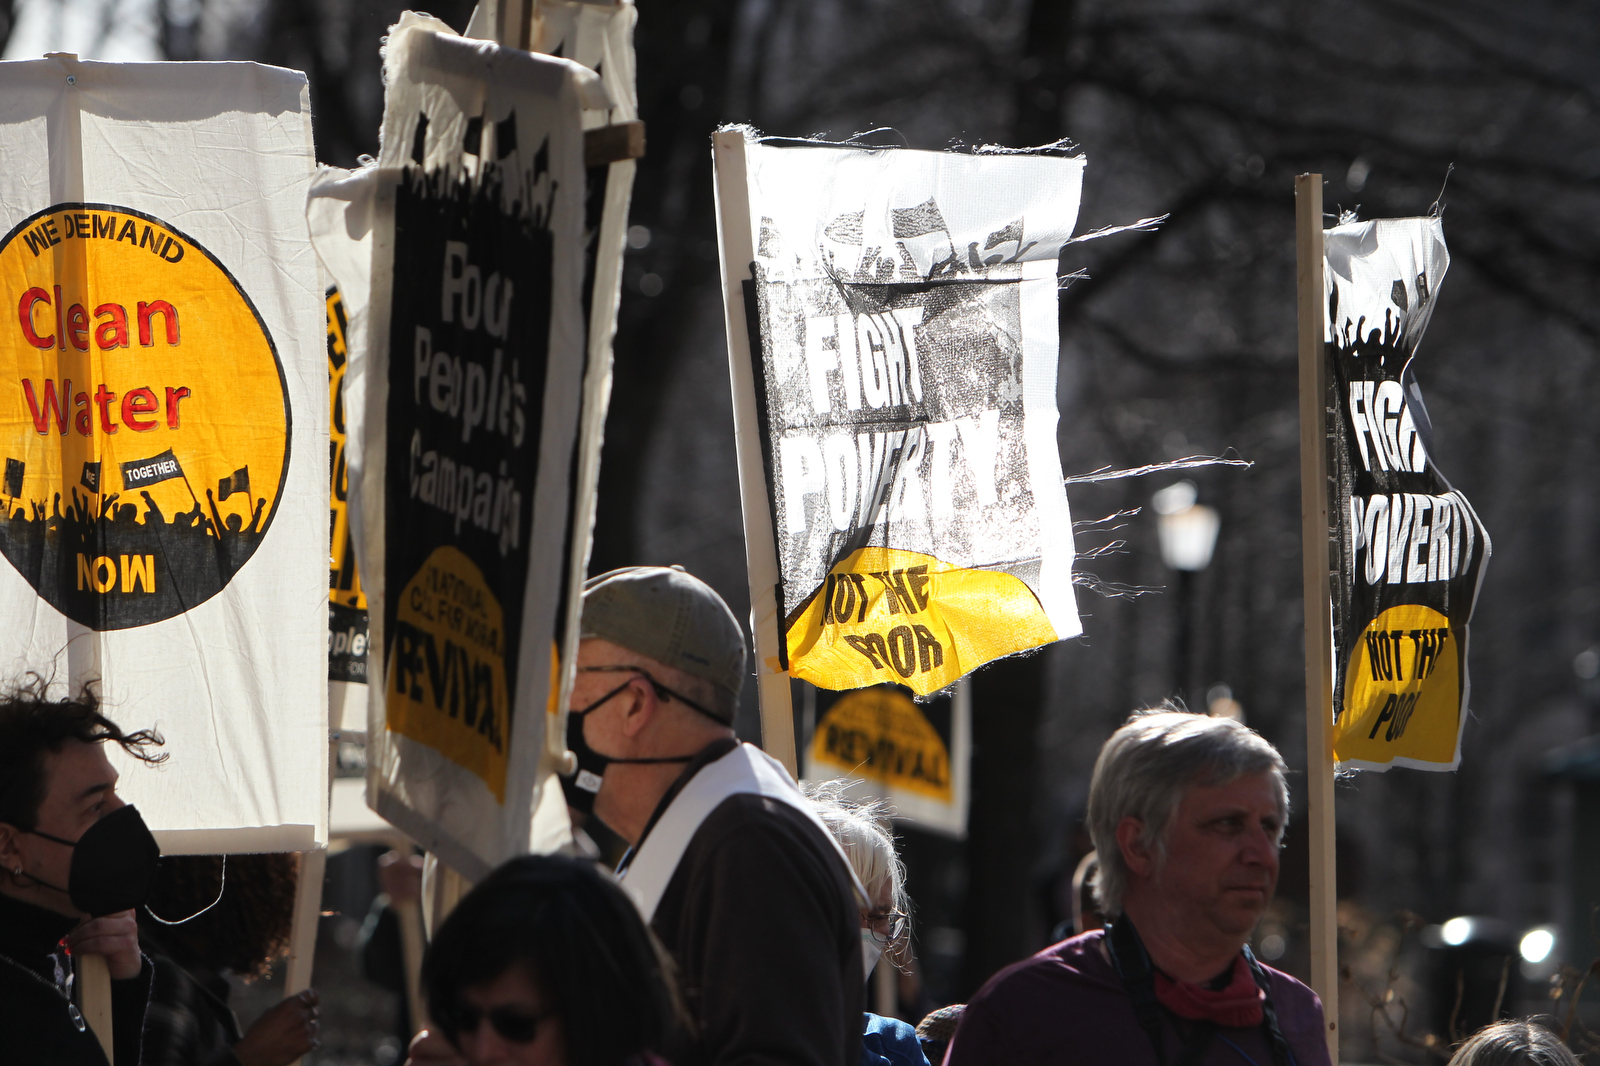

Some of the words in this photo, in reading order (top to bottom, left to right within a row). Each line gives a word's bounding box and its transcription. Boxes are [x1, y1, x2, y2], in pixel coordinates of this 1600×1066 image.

[23, 219, 61, 257] WE
[65, 214, 185, 264] DEMAND
[18, 285, 181, 352] Clean
[805, 306, 924, 415] FIGHT
[21, 378, 191, 437] Water
[1349, 380, 1428, 474] FIGH
[125, 460, 178, 482] TOGETHER
[779, 409, 1001, 536] POVERTY
[76, 552, 156, 594] NOW
[868, 564, 930, 616] THE
[1365, 630, 1403, 681] NOT
